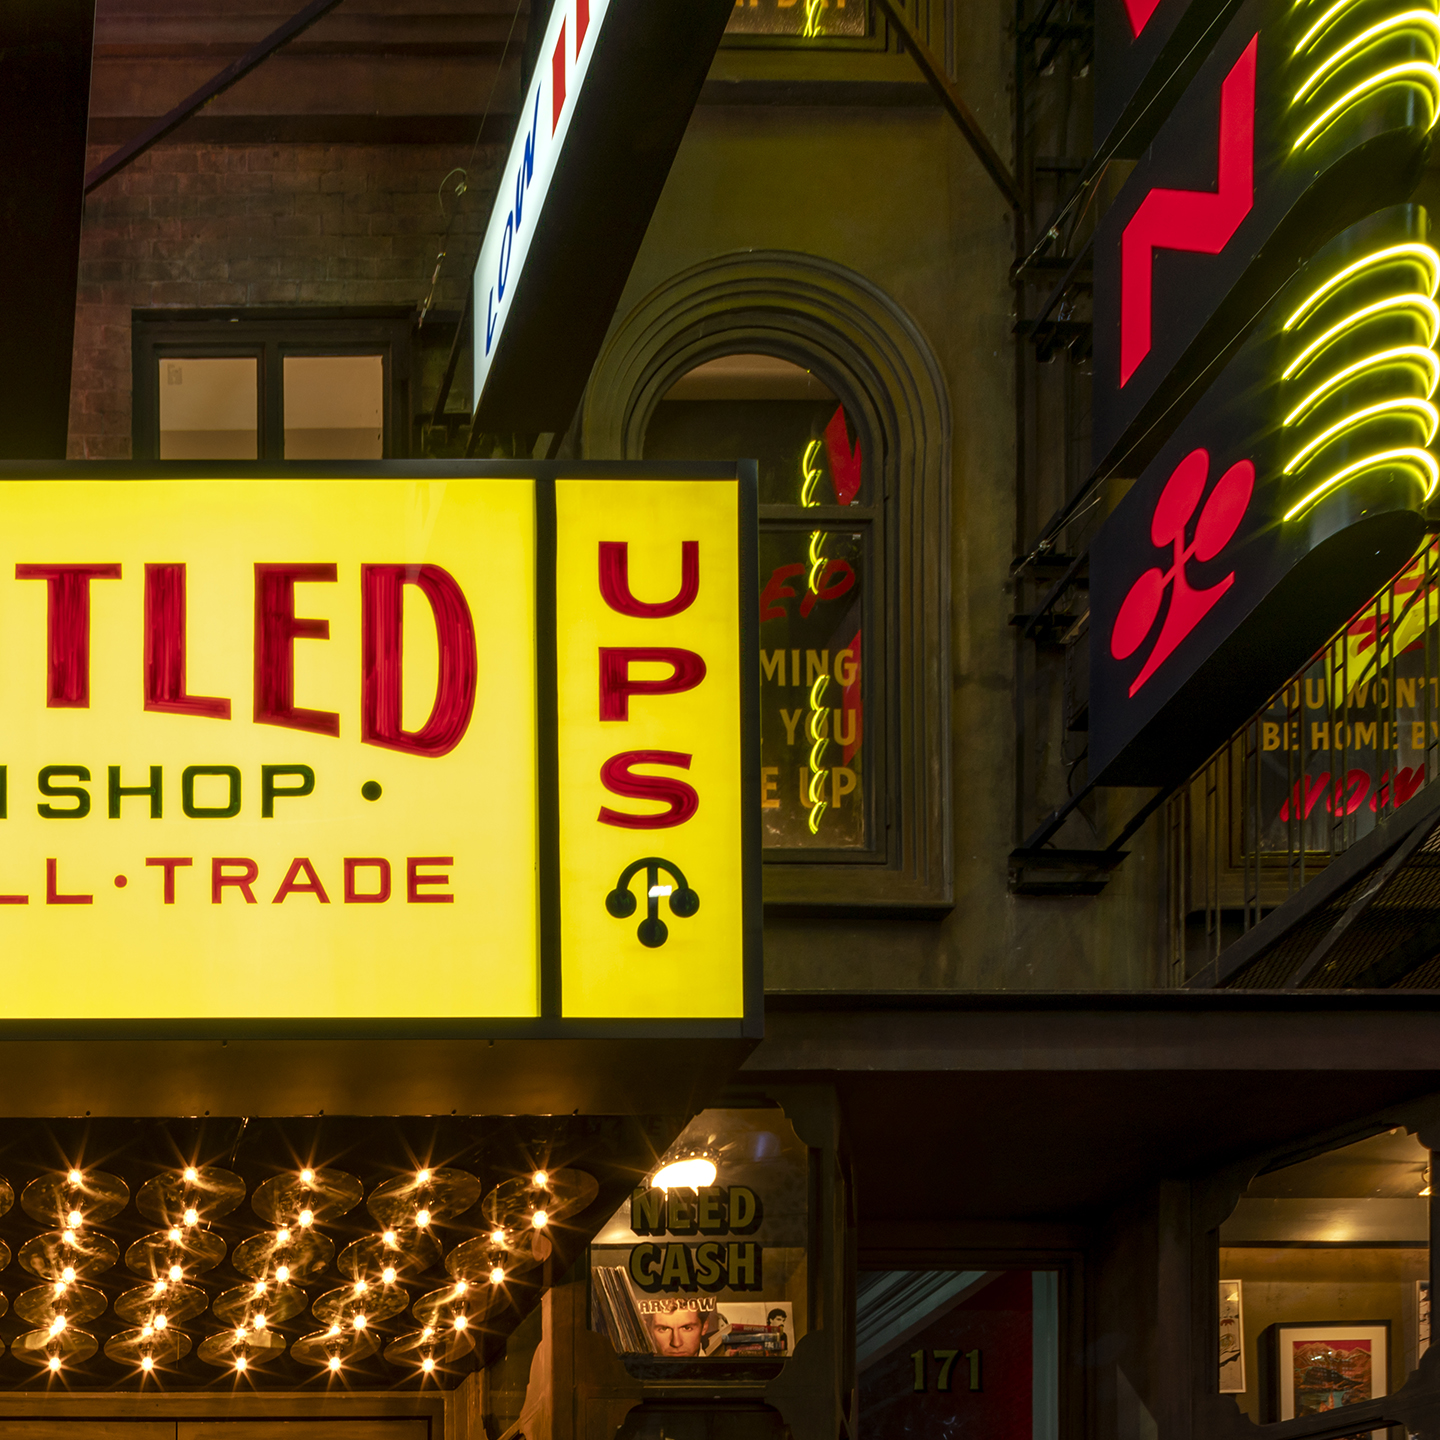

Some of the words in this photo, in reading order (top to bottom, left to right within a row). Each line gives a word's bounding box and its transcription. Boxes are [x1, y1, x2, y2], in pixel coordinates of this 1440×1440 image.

[597, 540, 707, 830] UPS
[779, 708, 857, 746] YOU
[1262, 721, 1300, 751] BE
[1311, 721, 1399, 751] HOME
[36, 764, 315, 819] SHOP
[799, 766, 857, 809] UP
[145, 856, 455, 904] TRADE
[631, 1186, 763, 1236] NEED
[629, 1242, 763, 1292] CASH
[910, 1349, 984, 1393] 171
